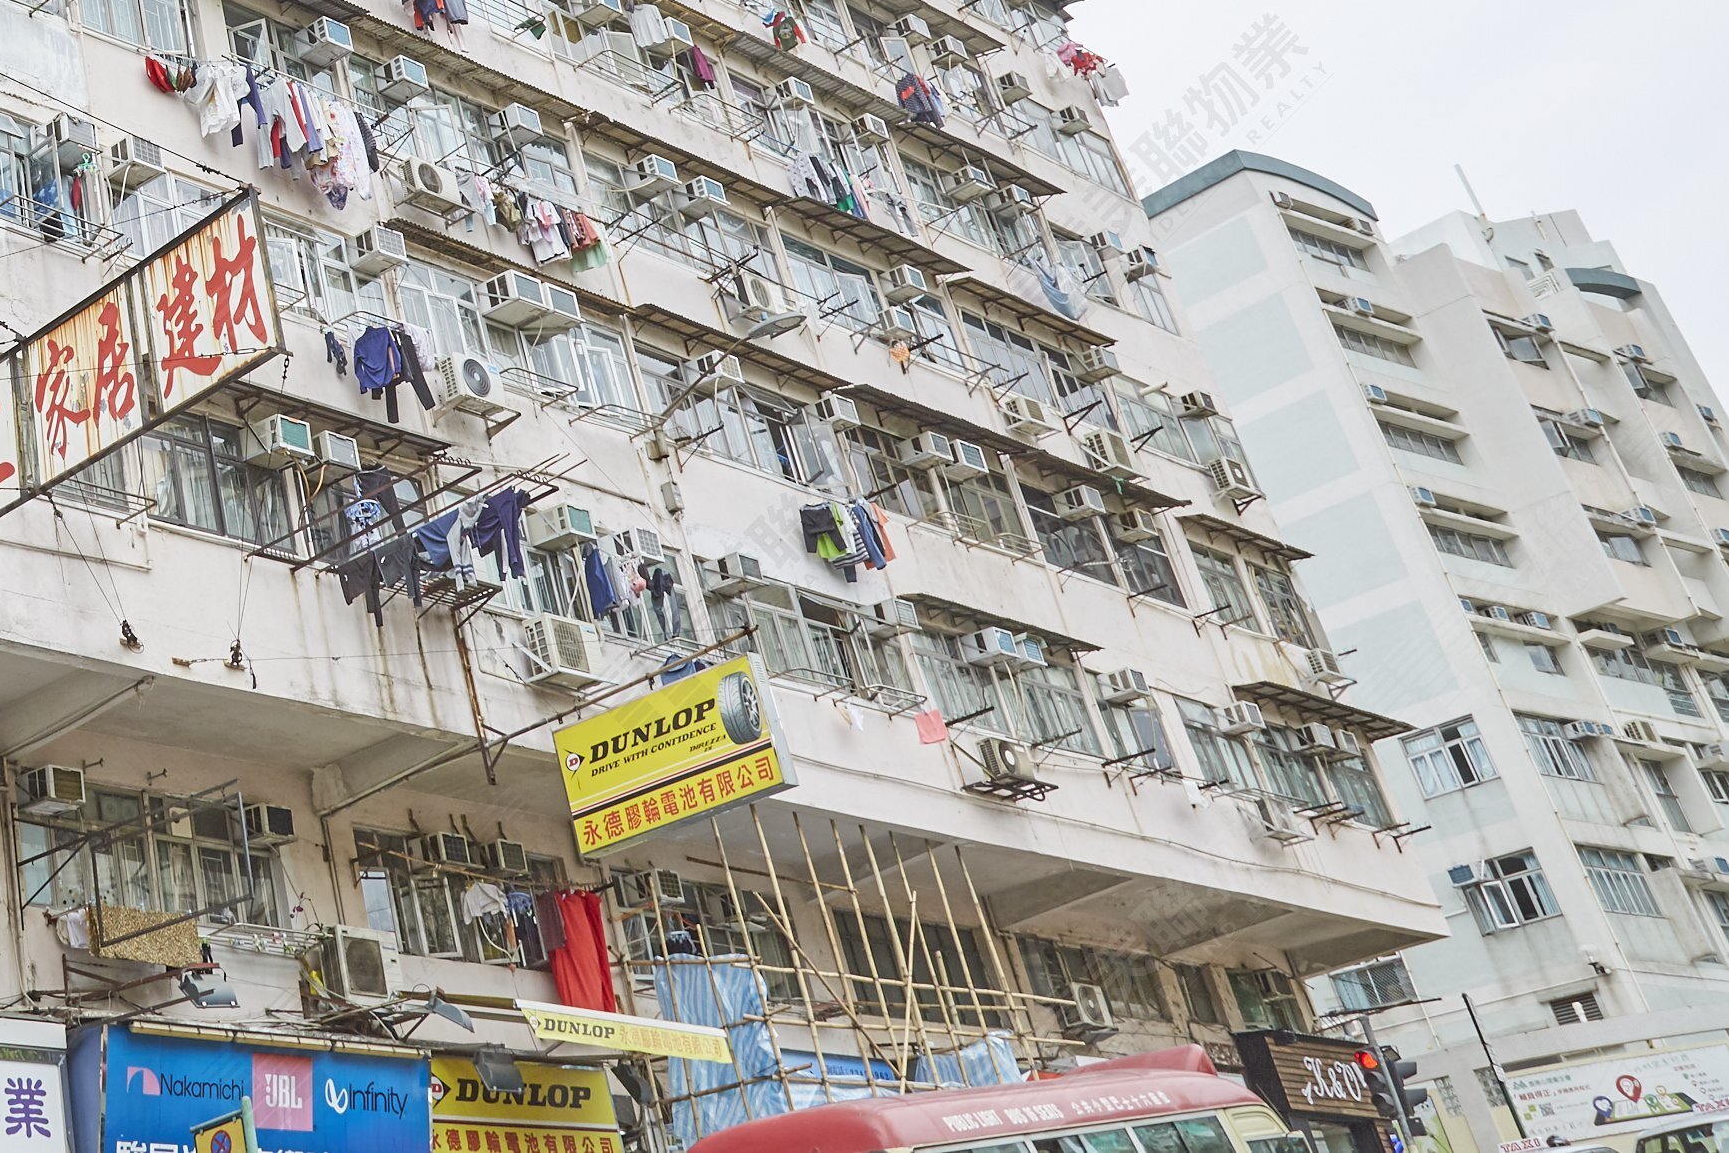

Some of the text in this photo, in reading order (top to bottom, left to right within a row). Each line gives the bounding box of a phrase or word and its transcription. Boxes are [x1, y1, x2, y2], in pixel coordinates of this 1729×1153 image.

[589, 698, 716, 764] DUNLOP
[591, 759, 621, 777] DRIVE
[623, 748, 650, 765] WITH
[650, 723, 717, 754] CONFIDENCE
[583, 756, 775, 847] 永德膠輪電池有限公司
[543, 1018, 615, 1039] DUNLOP
[159, 1073, 245, 1101] Nakamichi
[265, 1073, 303, 1109] JBL
[348, 1081, 408, 1120] Infinity
[1500, 1138, 1541, 1153] TAXI
